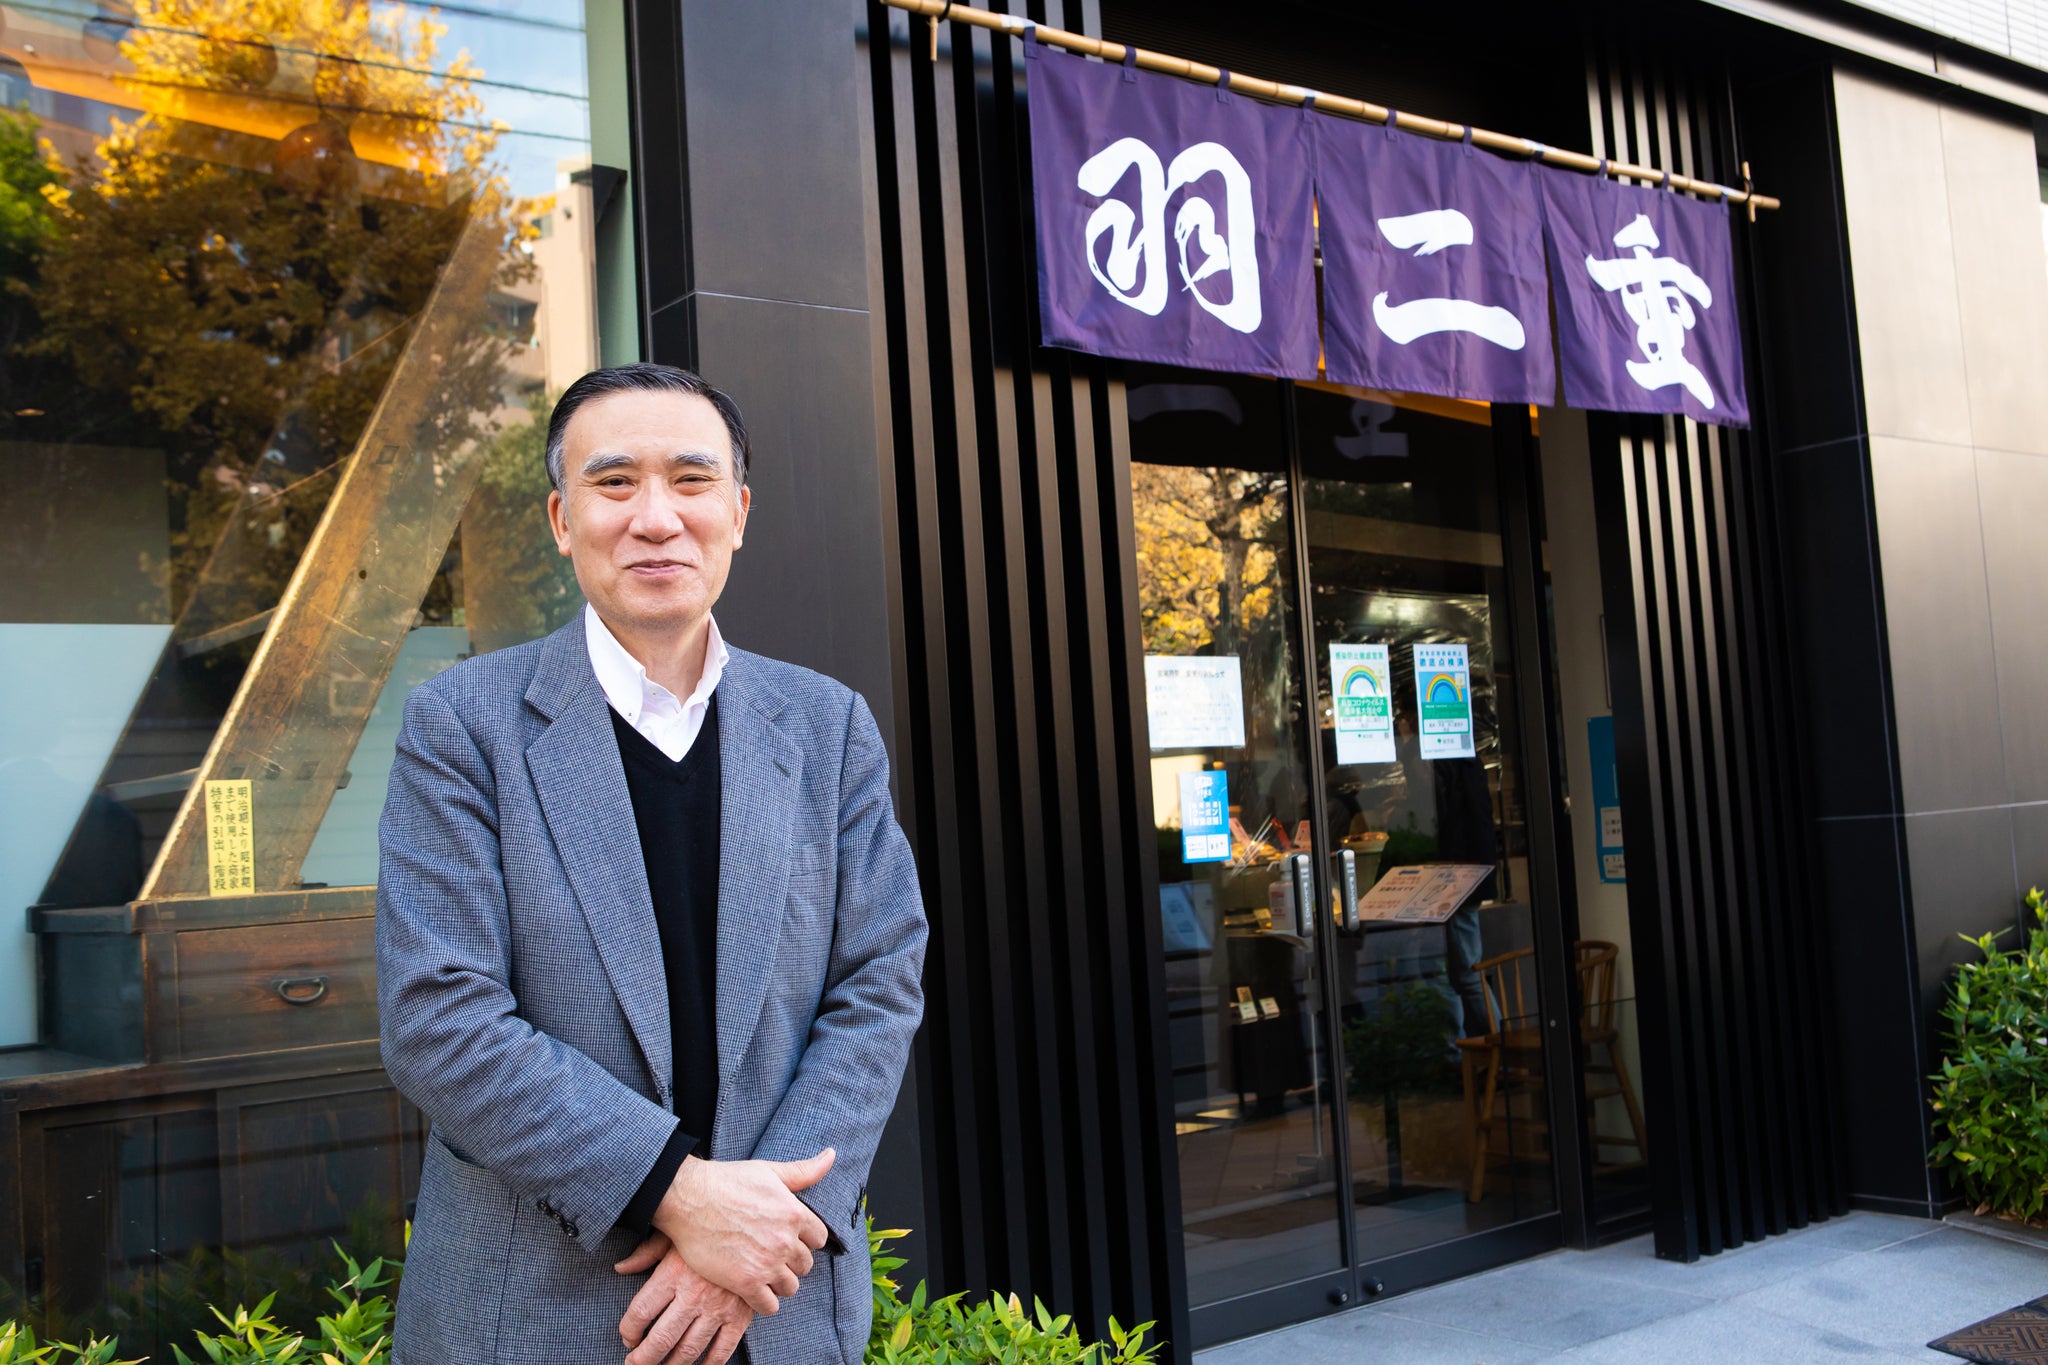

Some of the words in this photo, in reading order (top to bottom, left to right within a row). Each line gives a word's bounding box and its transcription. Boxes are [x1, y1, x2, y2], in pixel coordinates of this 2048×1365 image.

[1077, 136, 1715, 410] 羽二重
[237, 786, 251, 888] 明治期より昭和期
